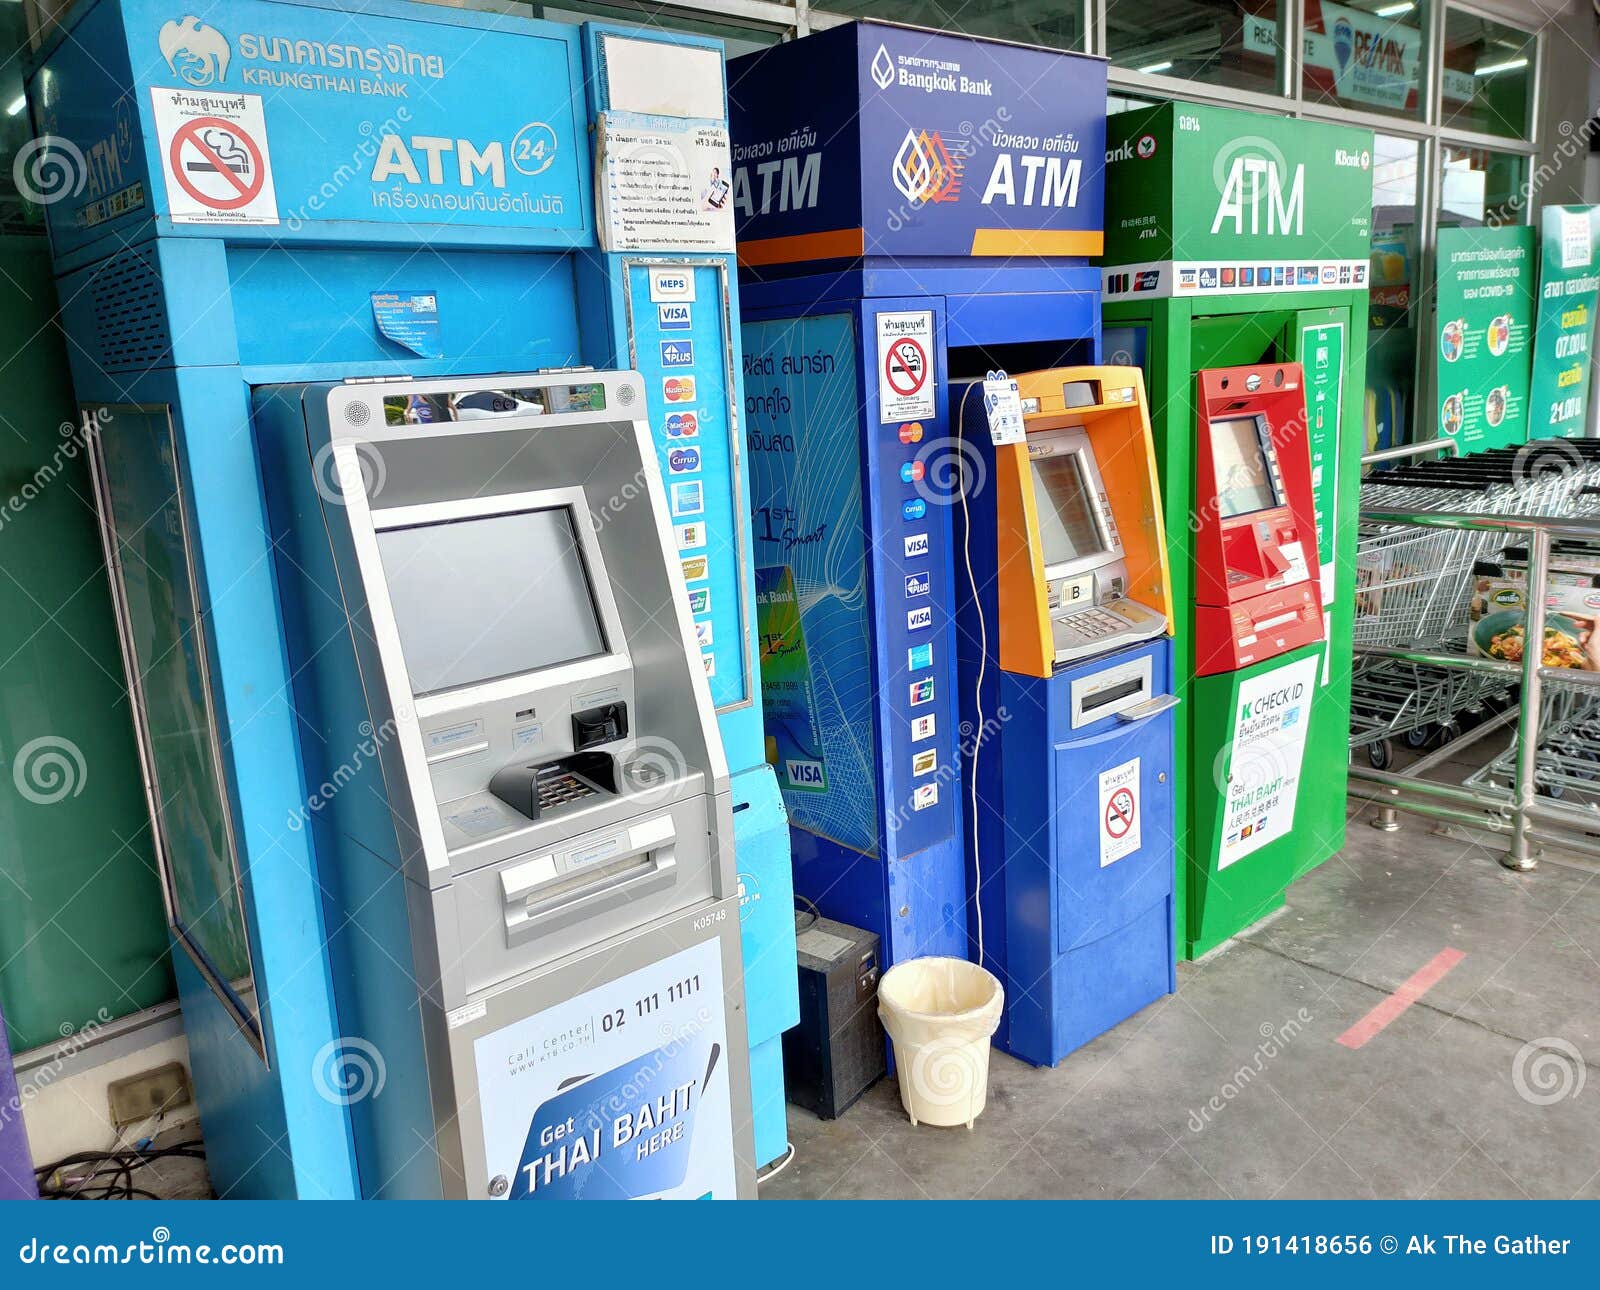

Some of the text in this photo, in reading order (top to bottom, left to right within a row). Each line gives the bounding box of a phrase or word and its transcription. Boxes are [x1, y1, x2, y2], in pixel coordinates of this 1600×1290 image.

[239, 33, 444, 79] ธนาคารกรุงไทย
[1354, 30, 1406, 75] RE/MAX
[242, 68, 408, 98] KRUNGTHAI BANK
[899, 69, 992, 96] Bangkok Bank
[171, 92, 246, 113] ห้ามสูบบุหรี่
[1179, 115, 1200, 131] ถอน
[777, 126, 816, 153] เอทีเอ็ม
[992, 128, 1079, 153] บัวหลวง เอทีเอ็ม
[86, 133, 123, 200] ATM
[371, 134, 544, 188] ATM 24
[1335, 149, 1361, 168] KBank
[732, 151, 821, 217] ATM
[980, 153, 1082, 207] ATM
[372, 182, 563, 215] เครื่องถอนเงินอัตโนมัติ
[1210, 157, 1305, 236] ATM
[1139, 228, 1157, 240] ATM
[660, 280, 684, 288] MEPS
[1479, 285, 1514, 298] COVID-19
[663, 308, 688, 319] VISA
[885, 315, 925, 332] ห้ามสูบบุหรี่
[671, 353, 691, 362] PLUS
[782, 349, 835, 375] สมาร์ท
[669, 420, 694, 429] Maestro
[672, 456, 697, 464] Cirrus
[783, 523, 827, 550] Smart
[907, 540, 928, 553] VISA
[769, 591, 794, 603] Bank
[913, 581, 929, 593] PLUS
[909, 611, 930, 626] VISA
[1241, 683, 1304, 721] K CHECK ID
[791, 764, 822, 783] VISA
[1230, 791, 1254, 814] THAI
[1256, 776, 1284, 801] BAHT
[693, 908, 727, 931] K05748
[507, 974, 701, 1065] Call Center 02 111 1111
[523, 1080, 696, 1193] THAI BAHT
[540, 1116, 575, 1147] Get
[636, 1120, 684, 1161] HERE
